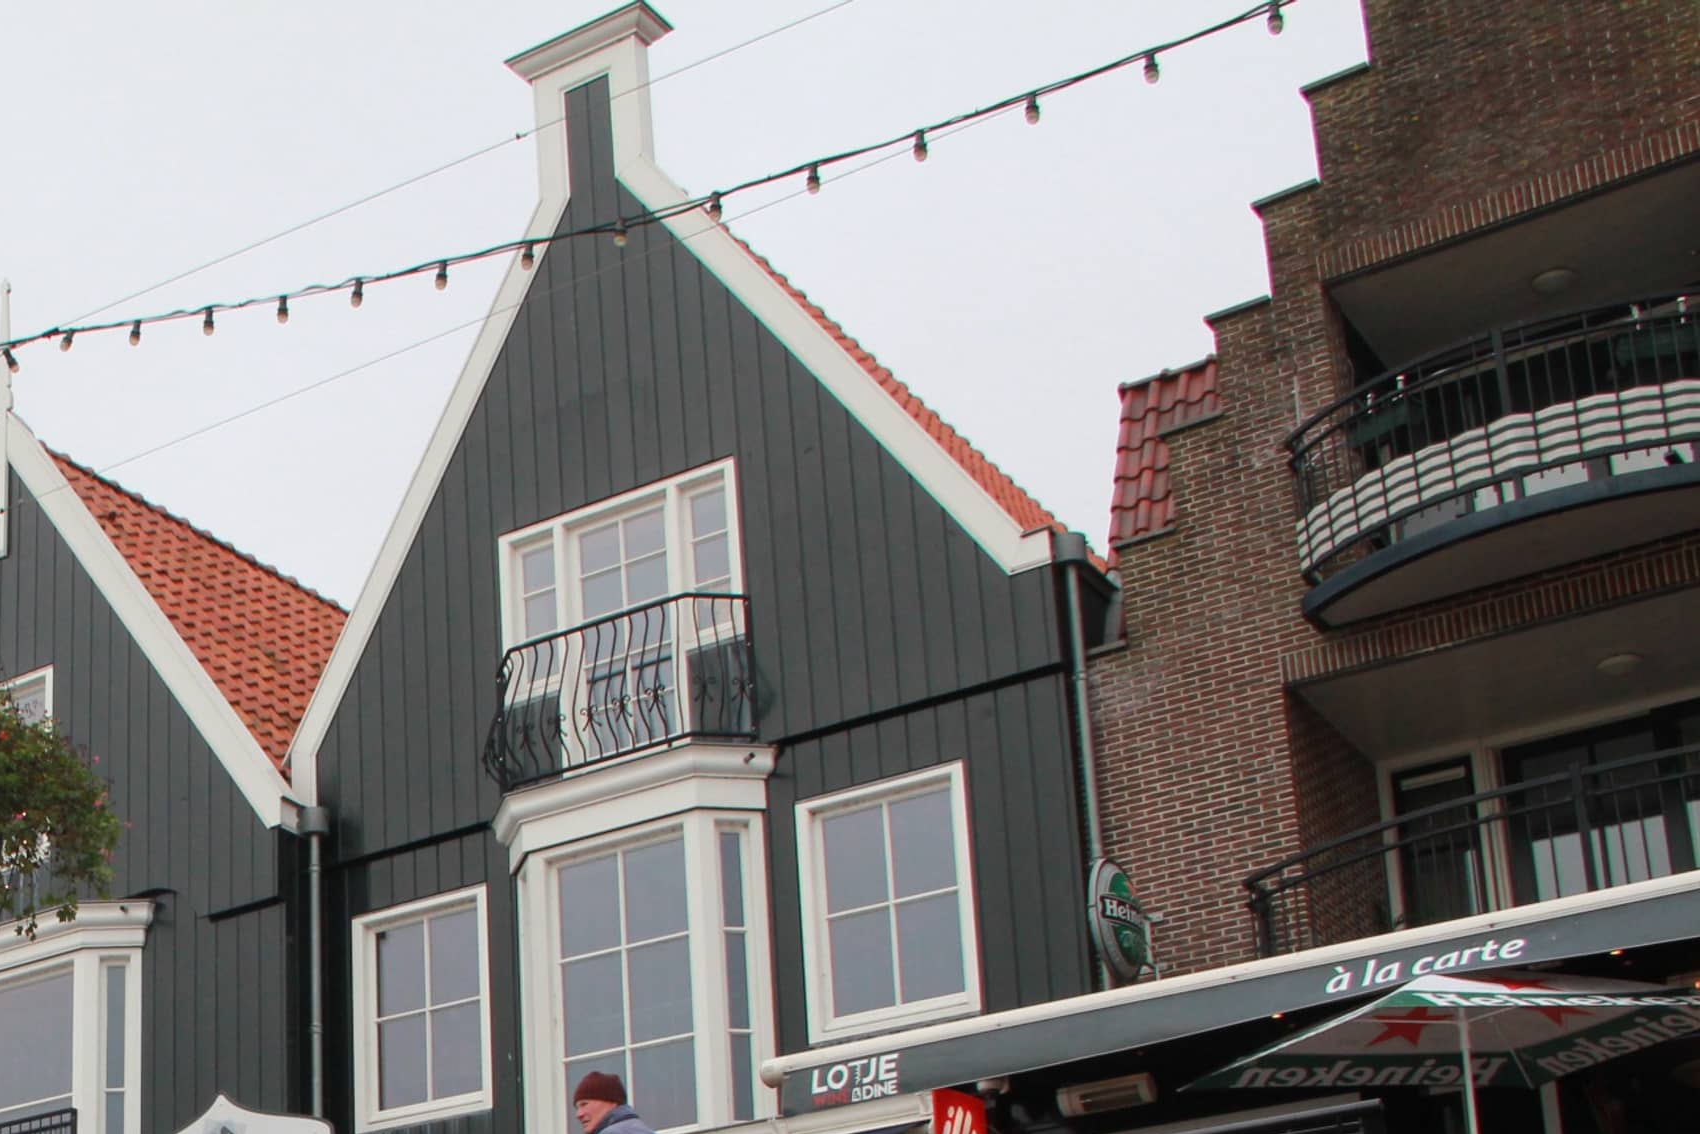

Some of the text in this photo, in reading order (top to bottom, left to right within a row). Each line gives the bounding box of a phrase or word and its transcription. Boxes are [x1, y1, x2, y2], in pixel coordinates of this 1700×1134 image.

[1324, 937, 1527, 994] à la carte
[811, 1053, 899, 1095] LOTJE
[862, 1080, 899, 1101] DINE
